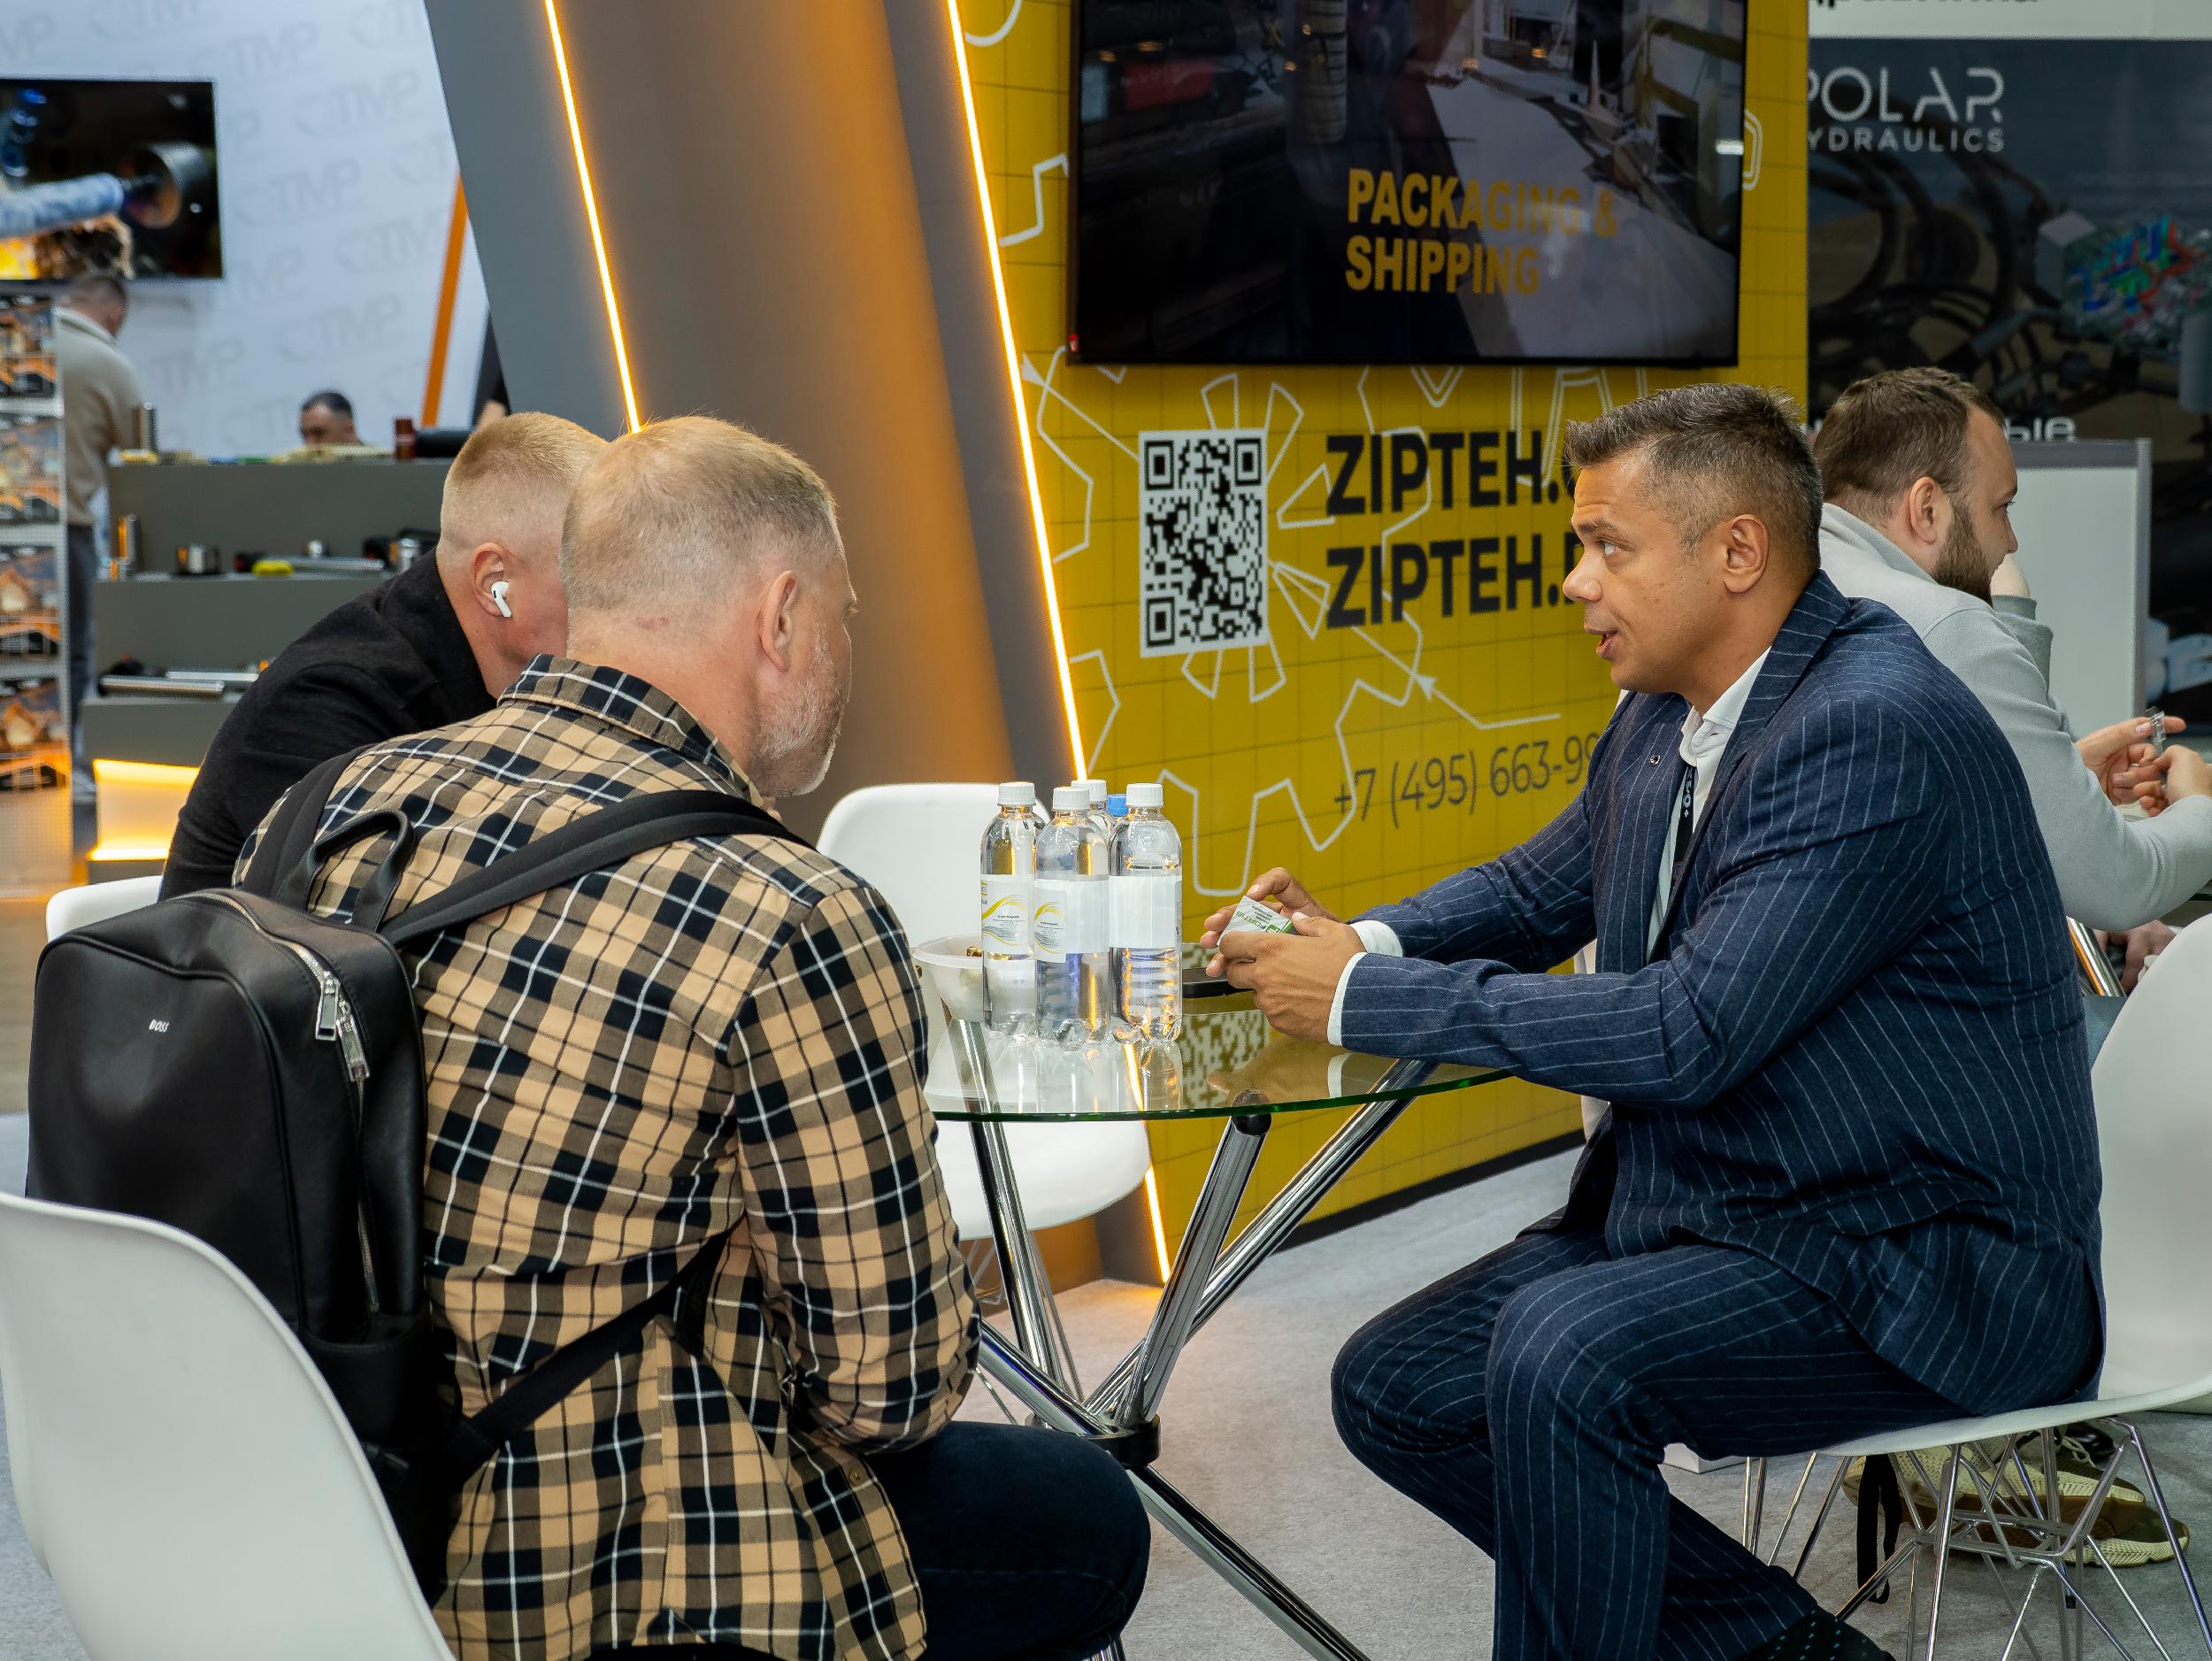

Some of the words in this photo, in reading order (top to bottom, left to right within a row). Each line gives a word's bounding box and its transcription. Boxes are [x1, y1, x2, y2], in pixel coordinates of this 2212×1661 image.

[1808, 127, 2005, 153] YDRAULICS
[1347, 167, 1582, 236] PACKAGING
[1594, 189, 1618, 238] &
[1345, 235, 1540, 296] SHIPPING
[1334, 768, 1376, 821] +7
[1390, 749, 1478, 829] (495)
